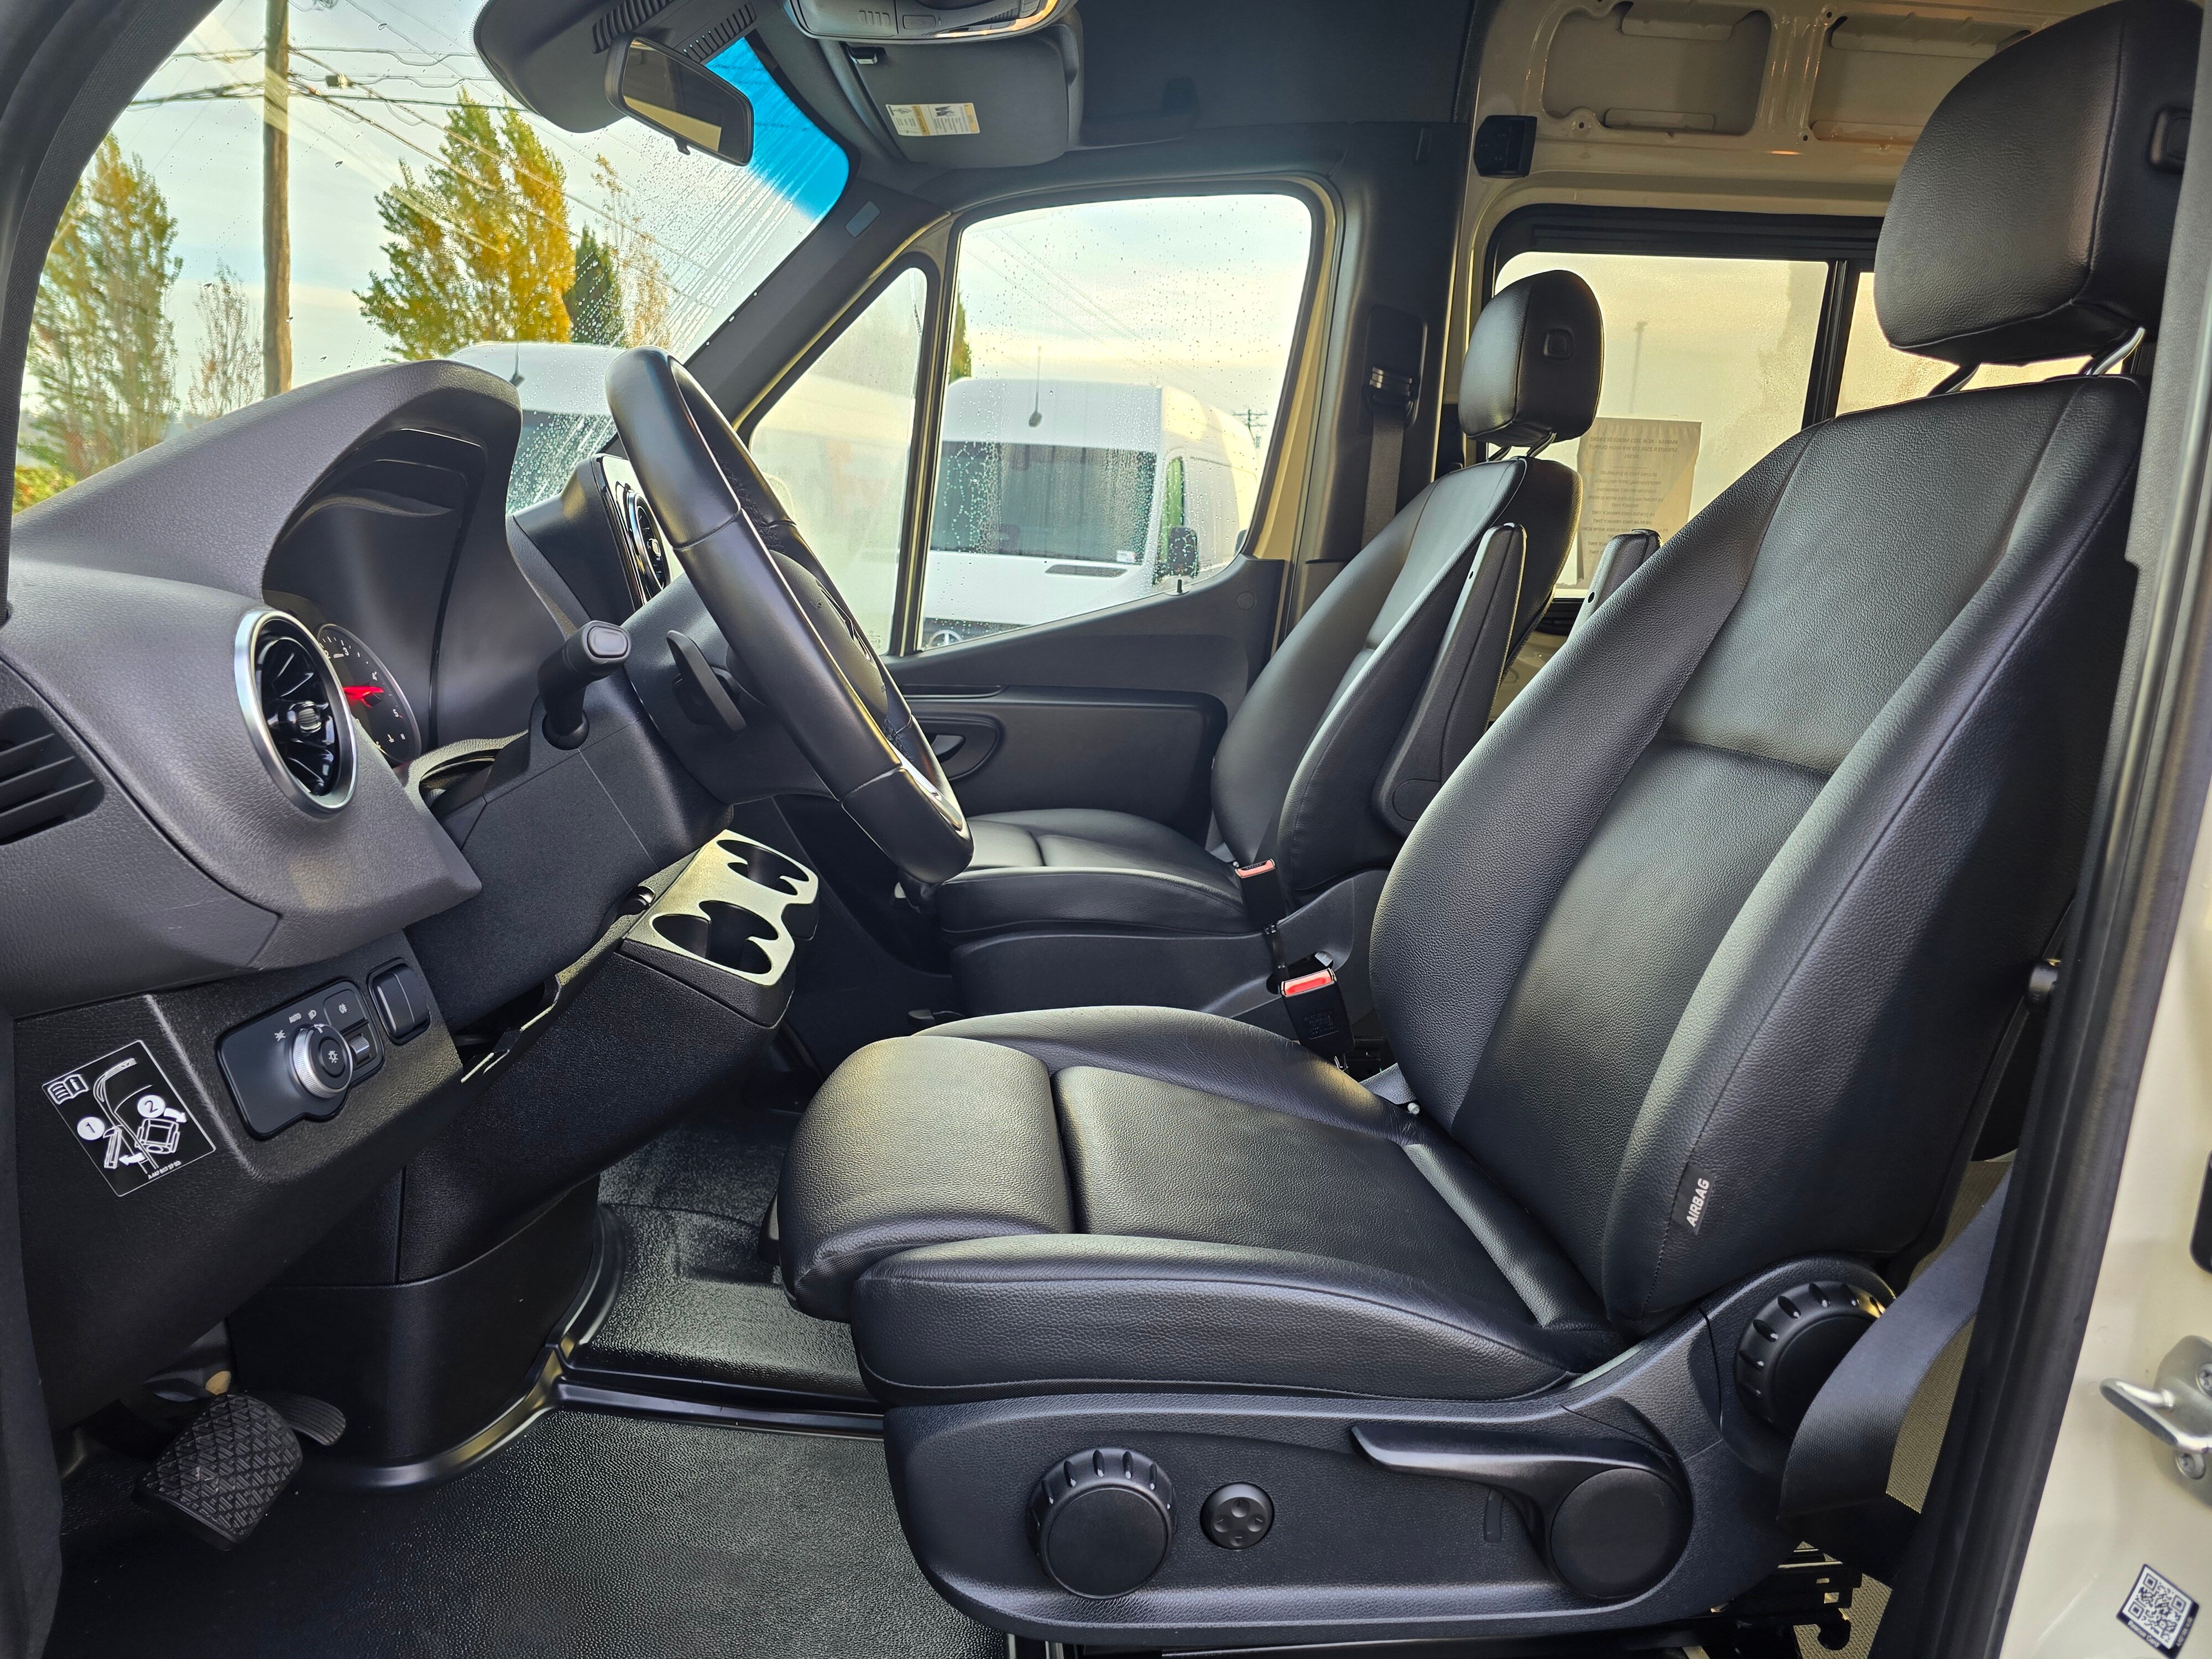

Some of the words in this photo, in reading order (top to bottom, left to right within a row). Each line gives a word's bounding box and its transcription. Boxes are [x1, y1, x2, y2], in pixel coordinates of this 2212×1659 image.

[343, 647, 349, 656] 3
[372, 672, 377, 681] 4
[392, 708, 399, 718] 5
[144, 1100, 158, 1113] 2
[86, 1121, 96, 1133] 1
[1686, 1178, 1710, 1228] AIRBAG
